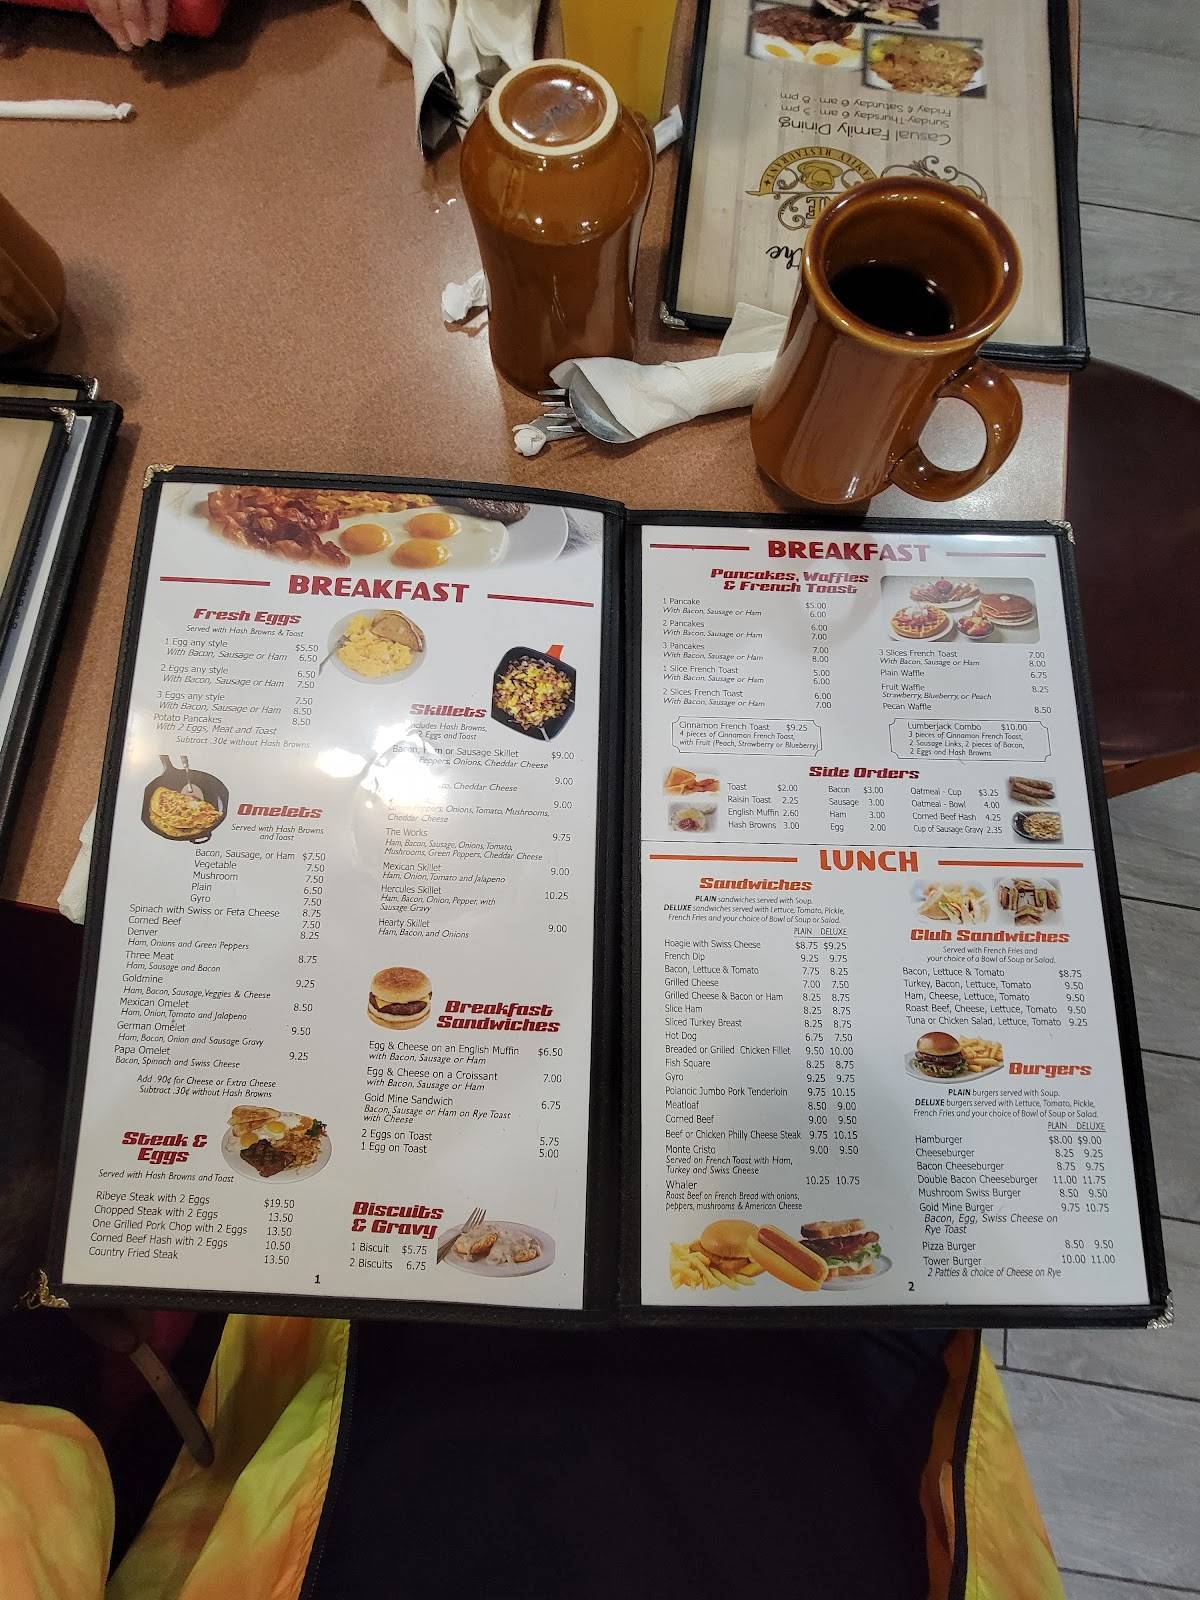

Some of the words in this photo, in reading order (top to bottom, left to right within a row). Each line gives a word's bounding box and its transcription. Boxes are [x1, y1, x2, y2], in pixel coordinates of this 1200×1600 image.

[780, 92, 799, 103] pm
[819, 96, 839, 106] am
[780, 104, 800, 115] pm
[819, 107, 839, 117] am
[853, 98, 904, 113] Saturday
[918, 105, 952, 117] Friday
[778, 116, 831, 136] Dining
[837, 122, 890, 141] Family
[895, 127, 952, 146] Casual
[765, 245, 803, 270] the
[767, 540, 930, 562] BREAKFAST
[710, 568, 800, 582] Pancakes,
[803, 572, 870, 584] Waffles
[288, 574, 470, 603] BREAKFAST
[723, 581, 736, 590] &
[739, 582, 801, 593] French
[806, 584, 858, 594] Toast
[669, 598, 701, 606] Pancake
[805, 602, 827, 610] $5.00
[193, 608, 251, 622] Fresh
[254, 611, 302, 626] Eggs
[172, 638, 189, 648] Egg
[191, 640, 206, 648] any
[208, 639, 228, 649] style
[295, 644, 319, 653] $5.50
[409, 703, 487, 718] Skillets
[882, 703, 906, 711] Pecan
[908, 703, 932, 711] Waffle
[1034, 706, 1052, 714] 8.50
[679, 721, 719, 730] Cinnamon
[720, 722, 747, 730] French
[750, 722, 770, 731] Toast
[785, 724, 808, 732] $9.25
[907, 722, 952, 731] Lumberjack
[954, 723, 982, 731] Combo
[1001, 723, 1028, 732] $10.00
[809, 766, 850, 778] Side
[854, 767, 920, 779] Orders
[727, 783, 747, 791] Toast
[777, 784, 798, 792] $2.00
[863, 786, 884, 794] $3.00
[727, 795, 750, 804] Raisin
[752, 796, 771, 804] Toast
[782, 797, 799, 805] 2.25
[237, 803, 324, 819] Omelets
[829, 810, 847, 818] Ham
[869, 811, 886, 819] 3.00
[830, 823, 844, 832] Egg
[194, 860, 237, 870] Vegetable
[306, 863, 325, 872] 7.50
[819, 849, 919, 872] LUNCH
[382, 862, 415, 871] Mexican
[417, 863, 442, 872] Skillet
[550, 867, 570, 876] 9.00
[192, 871, 239, 881] Mushroom
[305, 875, 324, 884] 7.50
[191, 882, 212, 892] Plain
[303, 886, 323, 895] 6.50
[699, 877, 813, 892] Sandwiches
[378, 918, 405, 928] Hearty
[406, 919, 430, 928] Skillet
[548, 924, 567, 934] 9.00
[793, 927, 813, 935] PLAIN
[820, 928, 848, 936] DELUXE
[127, 927, 159, 937] Denver
[300, 931, 320, 940] 8.25
[910, 928, 953, 941] Club
[956, 930, 1071, 943] Sandwiches
[943, 946, 966, 955] Served
[966, 946, 983, 955] with
[983, 946, 1007, 955] French
[1007, 947, 1023, 955] Fries
[664, 952, 690, 961] French
[692, 952, 706, 962] Dip
[800, 954, 819, 963] 9.25
[829, 954, 848, 963] 9.75
[902, 967, 930, 977] Bacon,
[932, 968, 963, 977] Lettuce
[965, 968, 972, 976] &
[975, 968, 1005, 977] Tomato
[1058, 969, 1082, 979] $8.75
[664, 978, 689, 987] Grilled
[691, 978, 719, 987] Cheese
[802, 980, 821, 989] 7.00
[831, 981, 849, 989] 7.50
[119, 997, 155, 1007] Mexican
[157, 998, 189, 1008] Omelet
[293, 1003, 313, 1012] 8.50
[444, 1000, 554, 1018] Breakfast
[436, 1015, 561, 1033] Sandwiches
[1008, 1062, 1093, 1078] Burgers
[665, 1100, 700, 1110] Meatloaf
[807, 1101, 827, 1111] 8.50
[837, 1102, 857, 1111] 9.00
[1047, 1122, 1068, 1131] PLAIN
[1076, 1122, 1106, 1131] DELUXE
[122, 1131, 189, 1147] Steak
[192, 1134, 208, 1148] &
[915, 1135, 963, 1145] Hamburger
[1048, 1135, 1073, 1146] $8.00
[1077, 1135, 1102, 1146] $9.00
[137, 1147, 190, 1165] Eggs
[915, 1148, 975, 1159] Cheeseburger
[1055, 1148, 1075, 1158] 8.25
[1083, 1149, 1104, 1158] 9.25
[665, 1180, 698, 1190] Whaler
[806, 1176, 830, 1185] 10.25
[835, 1176, 860, 1185] 10.75
[96, 1191, 127, 1202] Ribeye
[129, 1192, 155, 1202] Steak
[157, 1193, 177, 1203] with
[179, 1194, 186, 1203] 2
[188, 1194, 210, 1205] Eggs
[263, 1198, 295, 1209] $19.50
[352, 1201, 444, 1220] Biscuits
[351, 1218, 367, 1232] &
[371, 1219, 438, 1240] Gravy
[351, 1243, 356, 1252] 1
[359, 1243, 390, 1253] Biscuit
[401, 1245, 428, 1255] $5.75
[922, 1241, 944, 1251] Pizza
[946, 1241, 977, 1253] Burger
[1064, 1240, 1085, 1249] 8.50
[1093, 1240, 1114, 1249] 9.50
[88, 1247, 125, 1259] Country
[127, 1248, 150, 1259] Fried
[153, 1249, 179, 1260] Steak
[264, 1255, 290, 1265] 13.50
[922, 1256, 950, 1266] Tower
[952, 1256, 982, 1268] Burger
[1061, 1254, 1086, 1264] 10.00
[1091, 1255, 1116, 1264] 11.00
[349, 1258, 356, 1268] 2
[358, 1258, 393, 1270] Biscuits
[407, 1261, 426, 1271] 6.75
[314, 1274, 321, 1284] 1
[908, 1281, 915, 1292] 2
